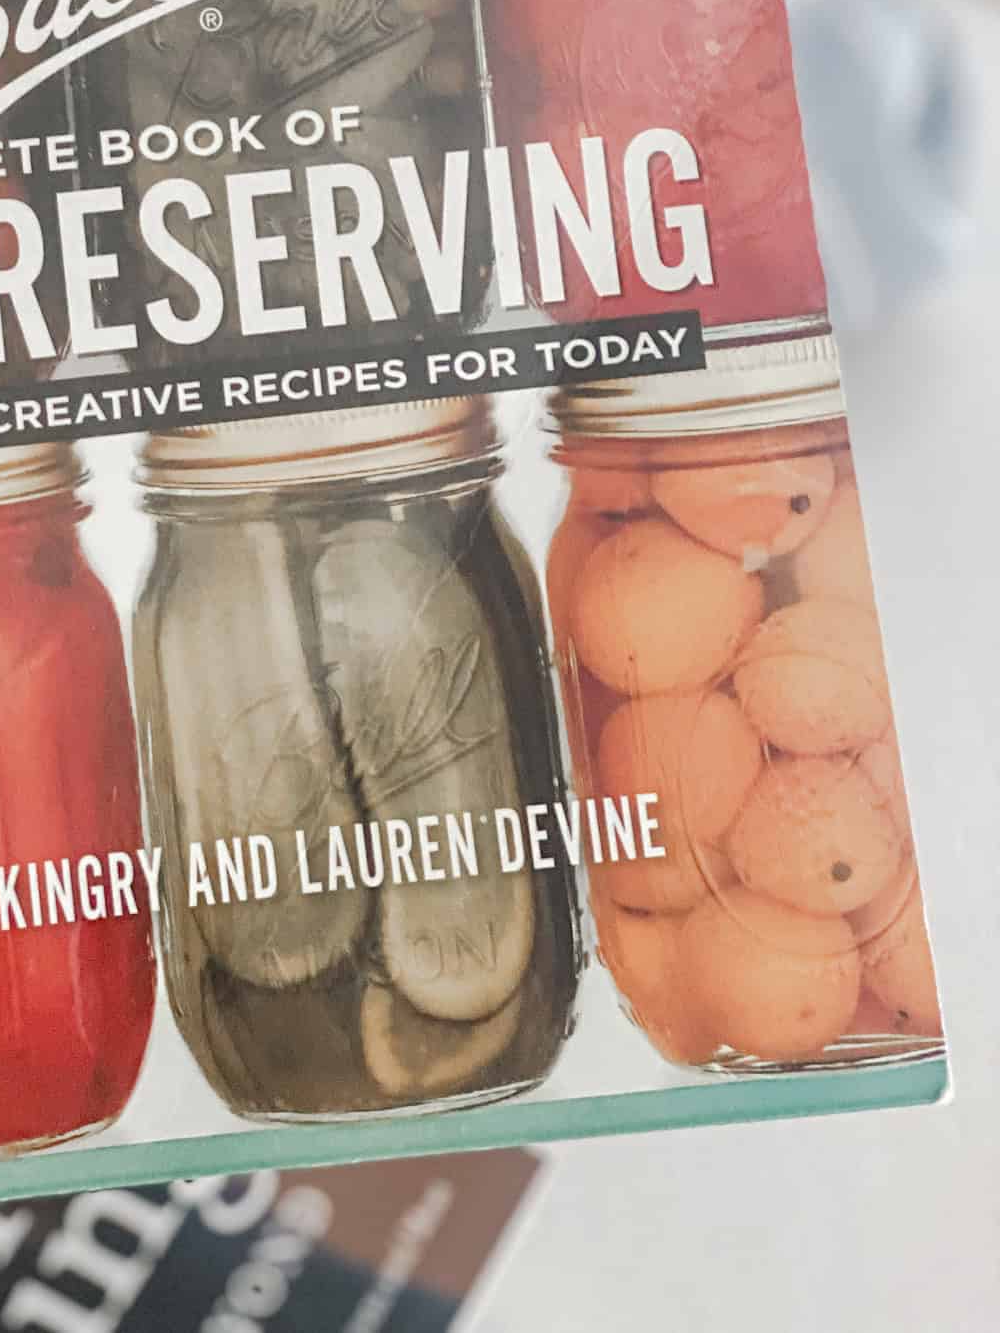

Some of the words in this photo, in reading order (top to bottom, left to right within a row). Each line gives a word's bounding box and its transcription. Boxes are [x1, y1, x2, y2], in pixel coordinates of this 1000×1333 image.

[98, 114, 266, 166] BOOK
[285, 105, 361, 146] OF
[222, 358, 408, 407] RECIPES
[427, 346, 517, 385] FOR
[535, 327, 687, 372] TODAY
[187, 834, 278, 907] AND
[295, 812, 480, 895] LAUREN
[494, 792, 667, 874] DEVINE
